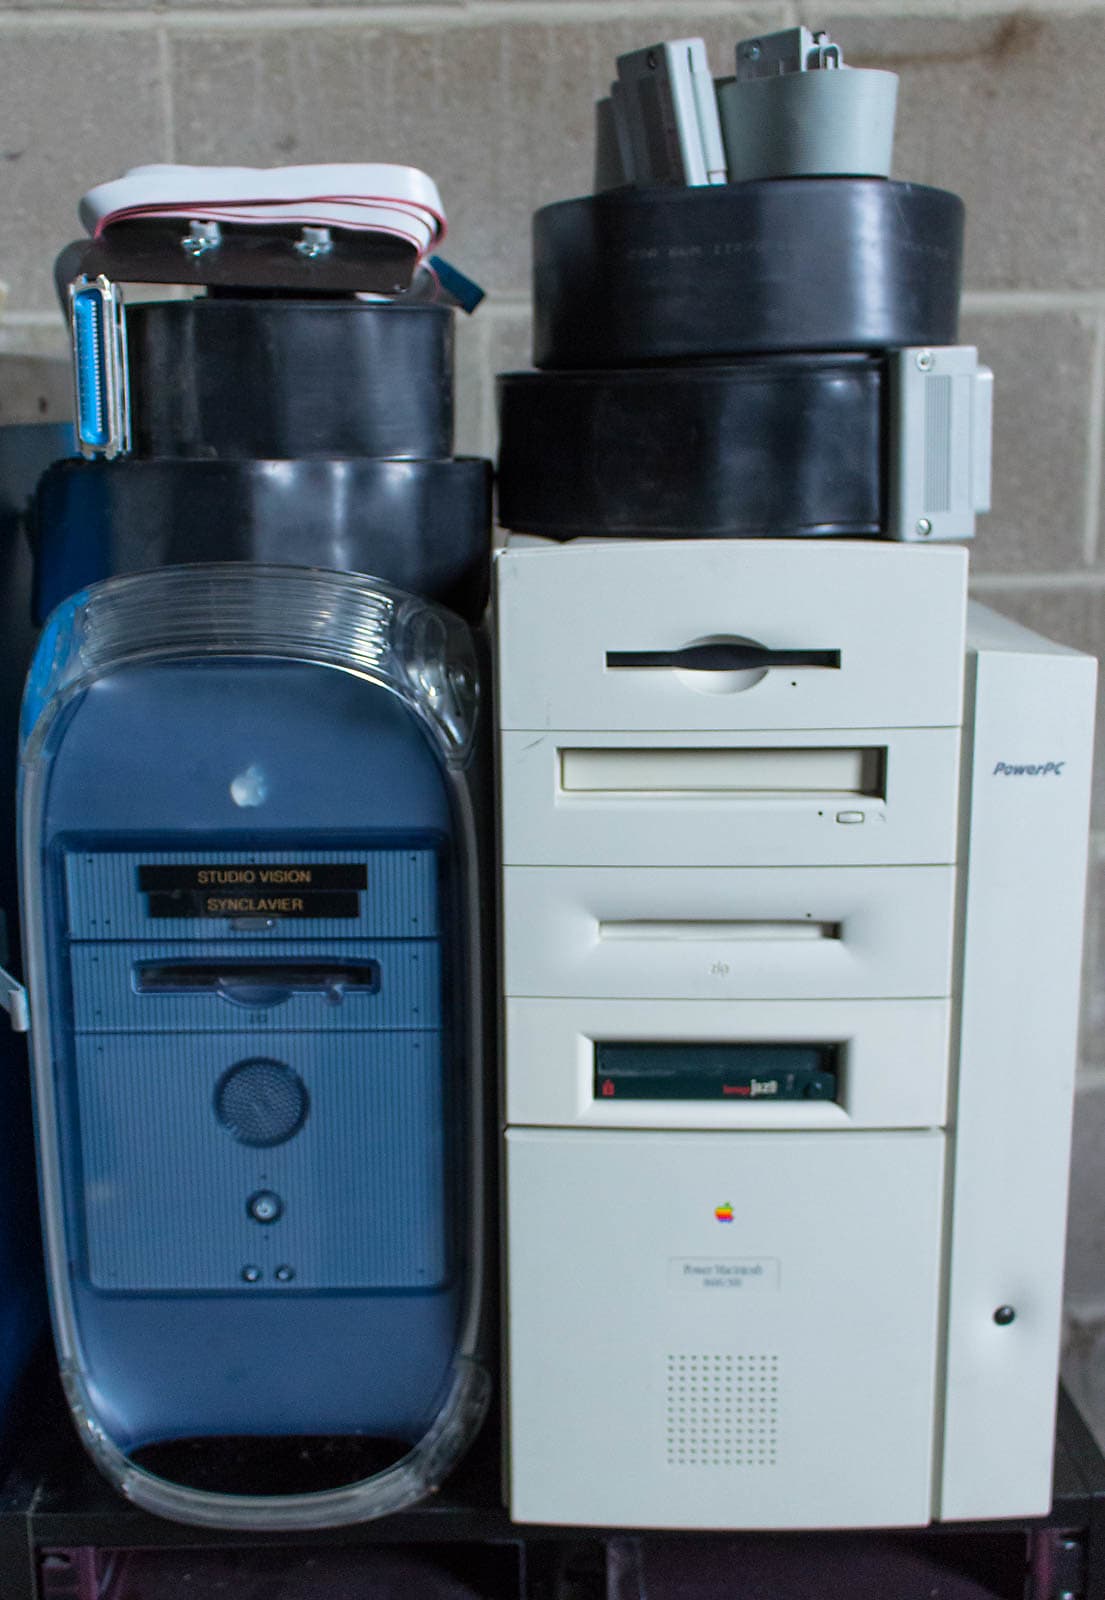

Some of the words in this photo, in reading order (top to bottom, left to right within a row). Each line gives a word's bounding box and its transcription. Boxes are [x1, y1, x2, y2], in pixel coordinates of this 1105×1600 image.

[993, 761, 1065, 775] PowerPC
[198, 870, 255, 884] STUDIO
[260, 869, 312, 883] VISION
[207, 898, 303, 912] SYNCLAVIER
